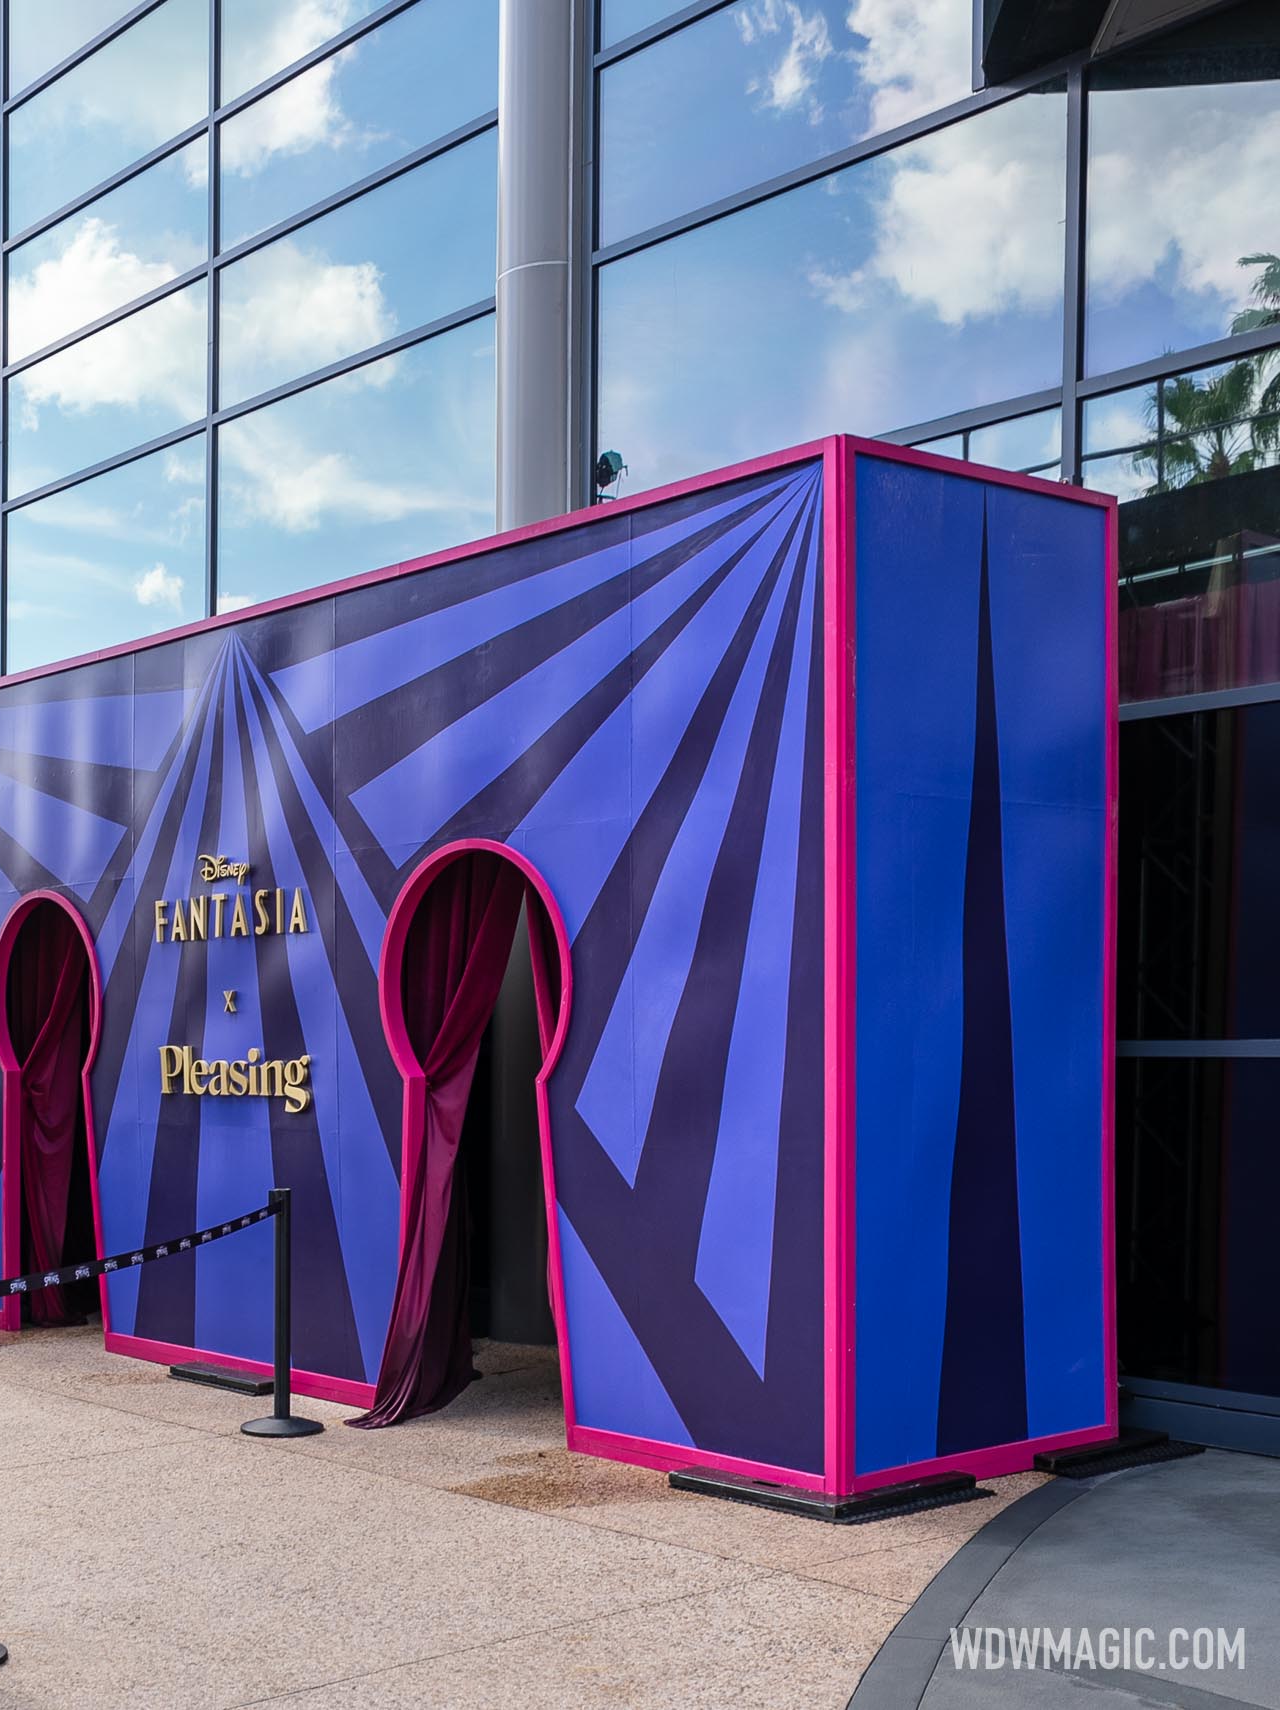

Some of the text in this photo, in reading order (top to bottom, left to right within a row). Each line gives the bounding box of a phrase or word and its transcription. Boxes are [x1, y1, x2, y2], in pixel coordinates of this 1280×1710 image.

[198, 854, 250, 885] Disney
[154, 887, 309, 943] FANTASIA
[158, 1045, 312, 1113] Pleasing
